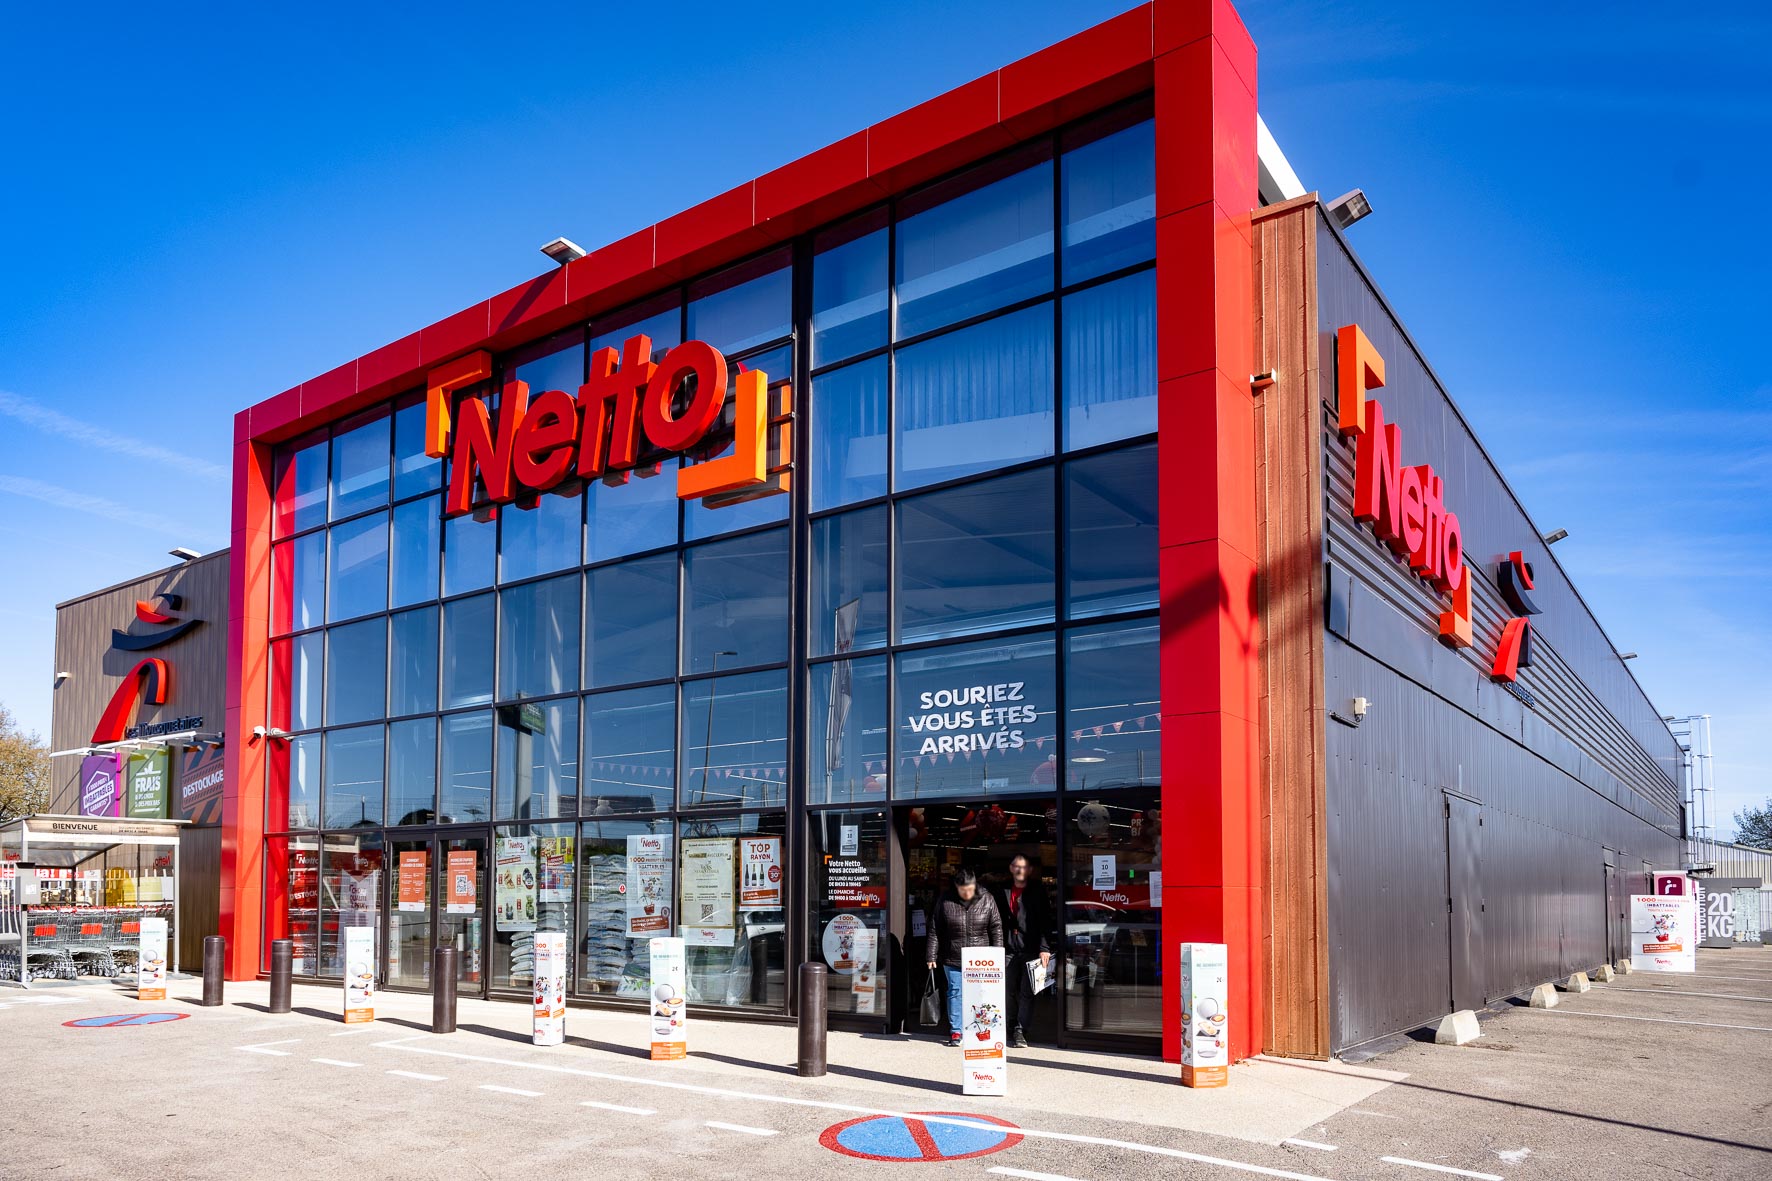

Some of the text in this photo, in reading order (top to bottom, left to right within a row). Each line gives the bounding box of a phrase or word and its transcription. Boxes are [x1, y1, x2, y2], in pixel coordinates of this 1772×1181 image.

[447, 333, 728, 516] Netto
[1354, 399, 1463, 592] Netto
[920, 681, 1024, 710] SOURIEZ
[908, 703, 1037, 733] VOUS ÊTES
[919, 725, 1024, 755] ARRIVÉS
[135, 776, 161, 793] FRAIS
[182, 769, 224, 799] DESTOCKAGE
[52, 822, 98, 831] BIENVENUE
[642, 839, 659, 848] Netto
[750, 842, 771, 853] TOP
[1102, 893, 1127, 902] Netto
[1707, 892, 1732, 916] 20
[1707, 915, 1733, 938] KG
[974, 1073, 993, 1081] Netto
